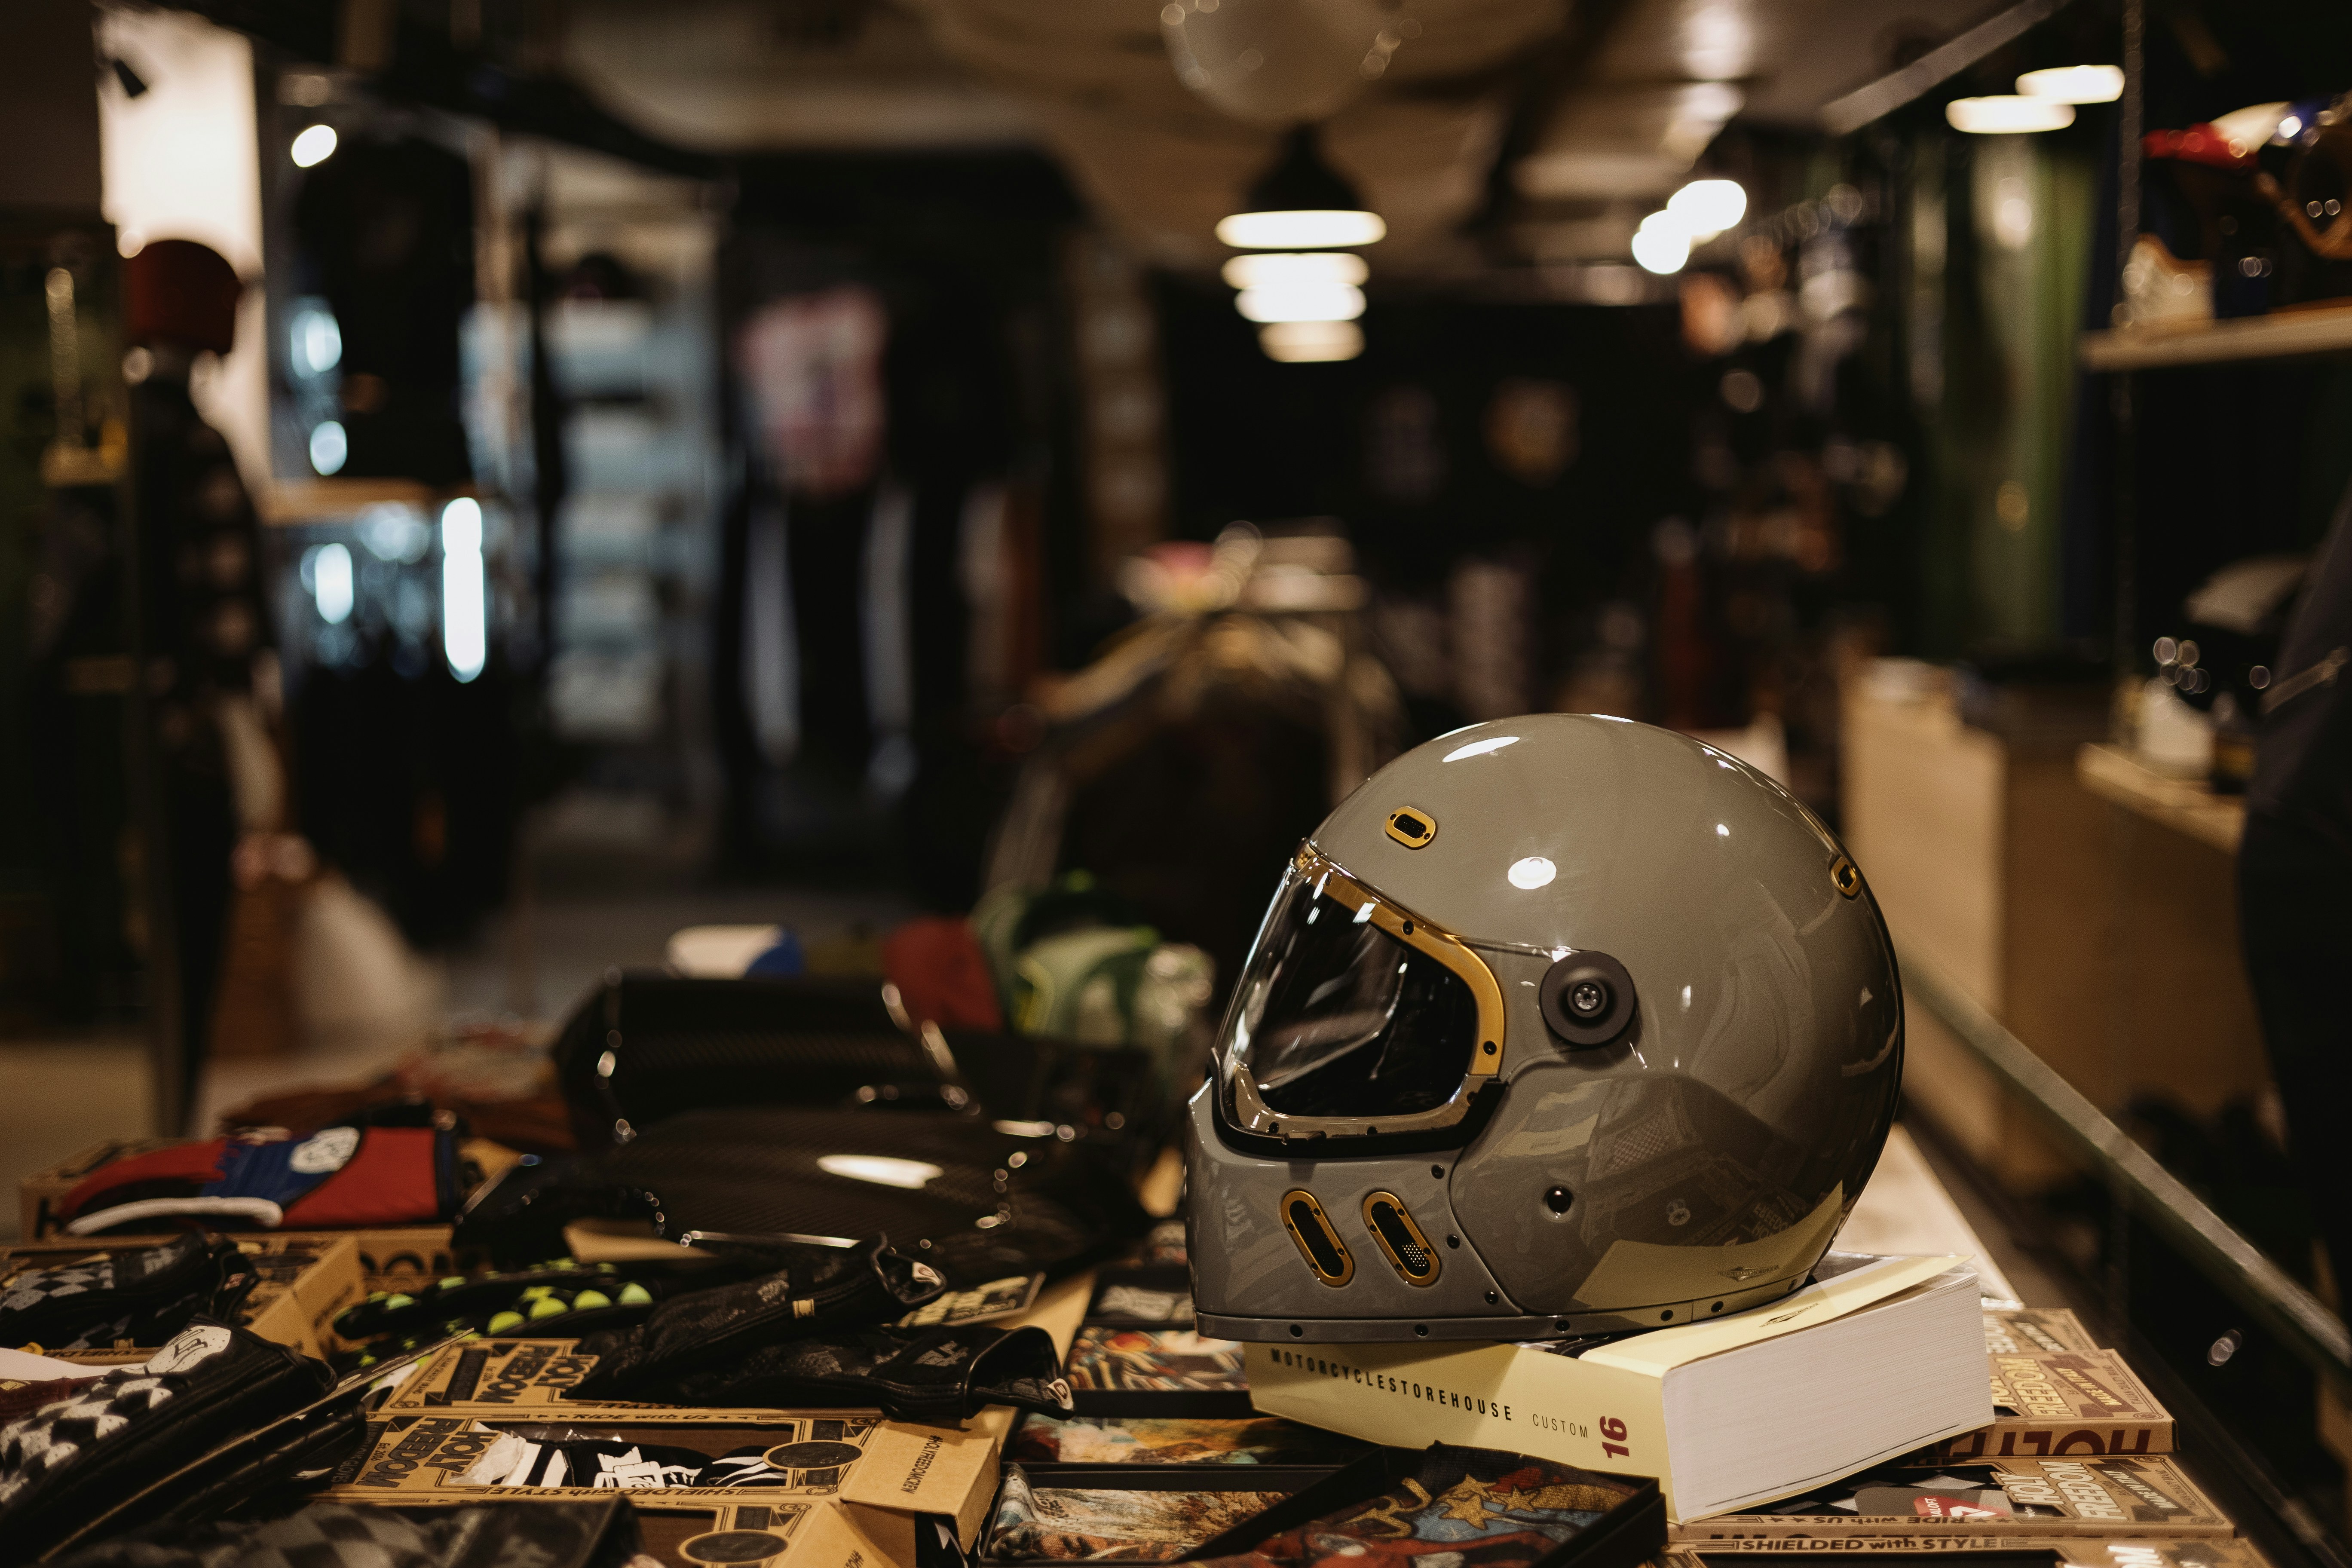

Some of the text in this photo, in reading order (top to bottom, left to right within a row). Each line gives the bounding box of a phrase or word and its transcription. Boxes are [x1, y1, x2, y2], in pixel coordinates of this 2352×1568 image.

[475, 1344, 559, 1403] FREEDOM
[1995, 1357, 2077, 1416] FREEDOM
[2055, 1367, 2089, 1383] ITALY
[2086, 1389, 2122, 1406] MADE
[425, 1431, 498, 1473] HOLY
[1532, 1413, 1588, 1439] CUSTOM
[1599, 1415, 1629, 1459] 16
[355, 1418, 466, 1488] FREEDOM
[331, 1460, 359, 1483] GLOVES
[2102, 1470, 2141, 1484] ITALY
[1997, 1472, 2065, 1505] HOLY
[2038, 1461, 2128, 1520] FREEDOM
[2137, 1491, 2179, 1509] MADE
[1742, 1538, 1997, 1550] SHIELDED with STYLE
